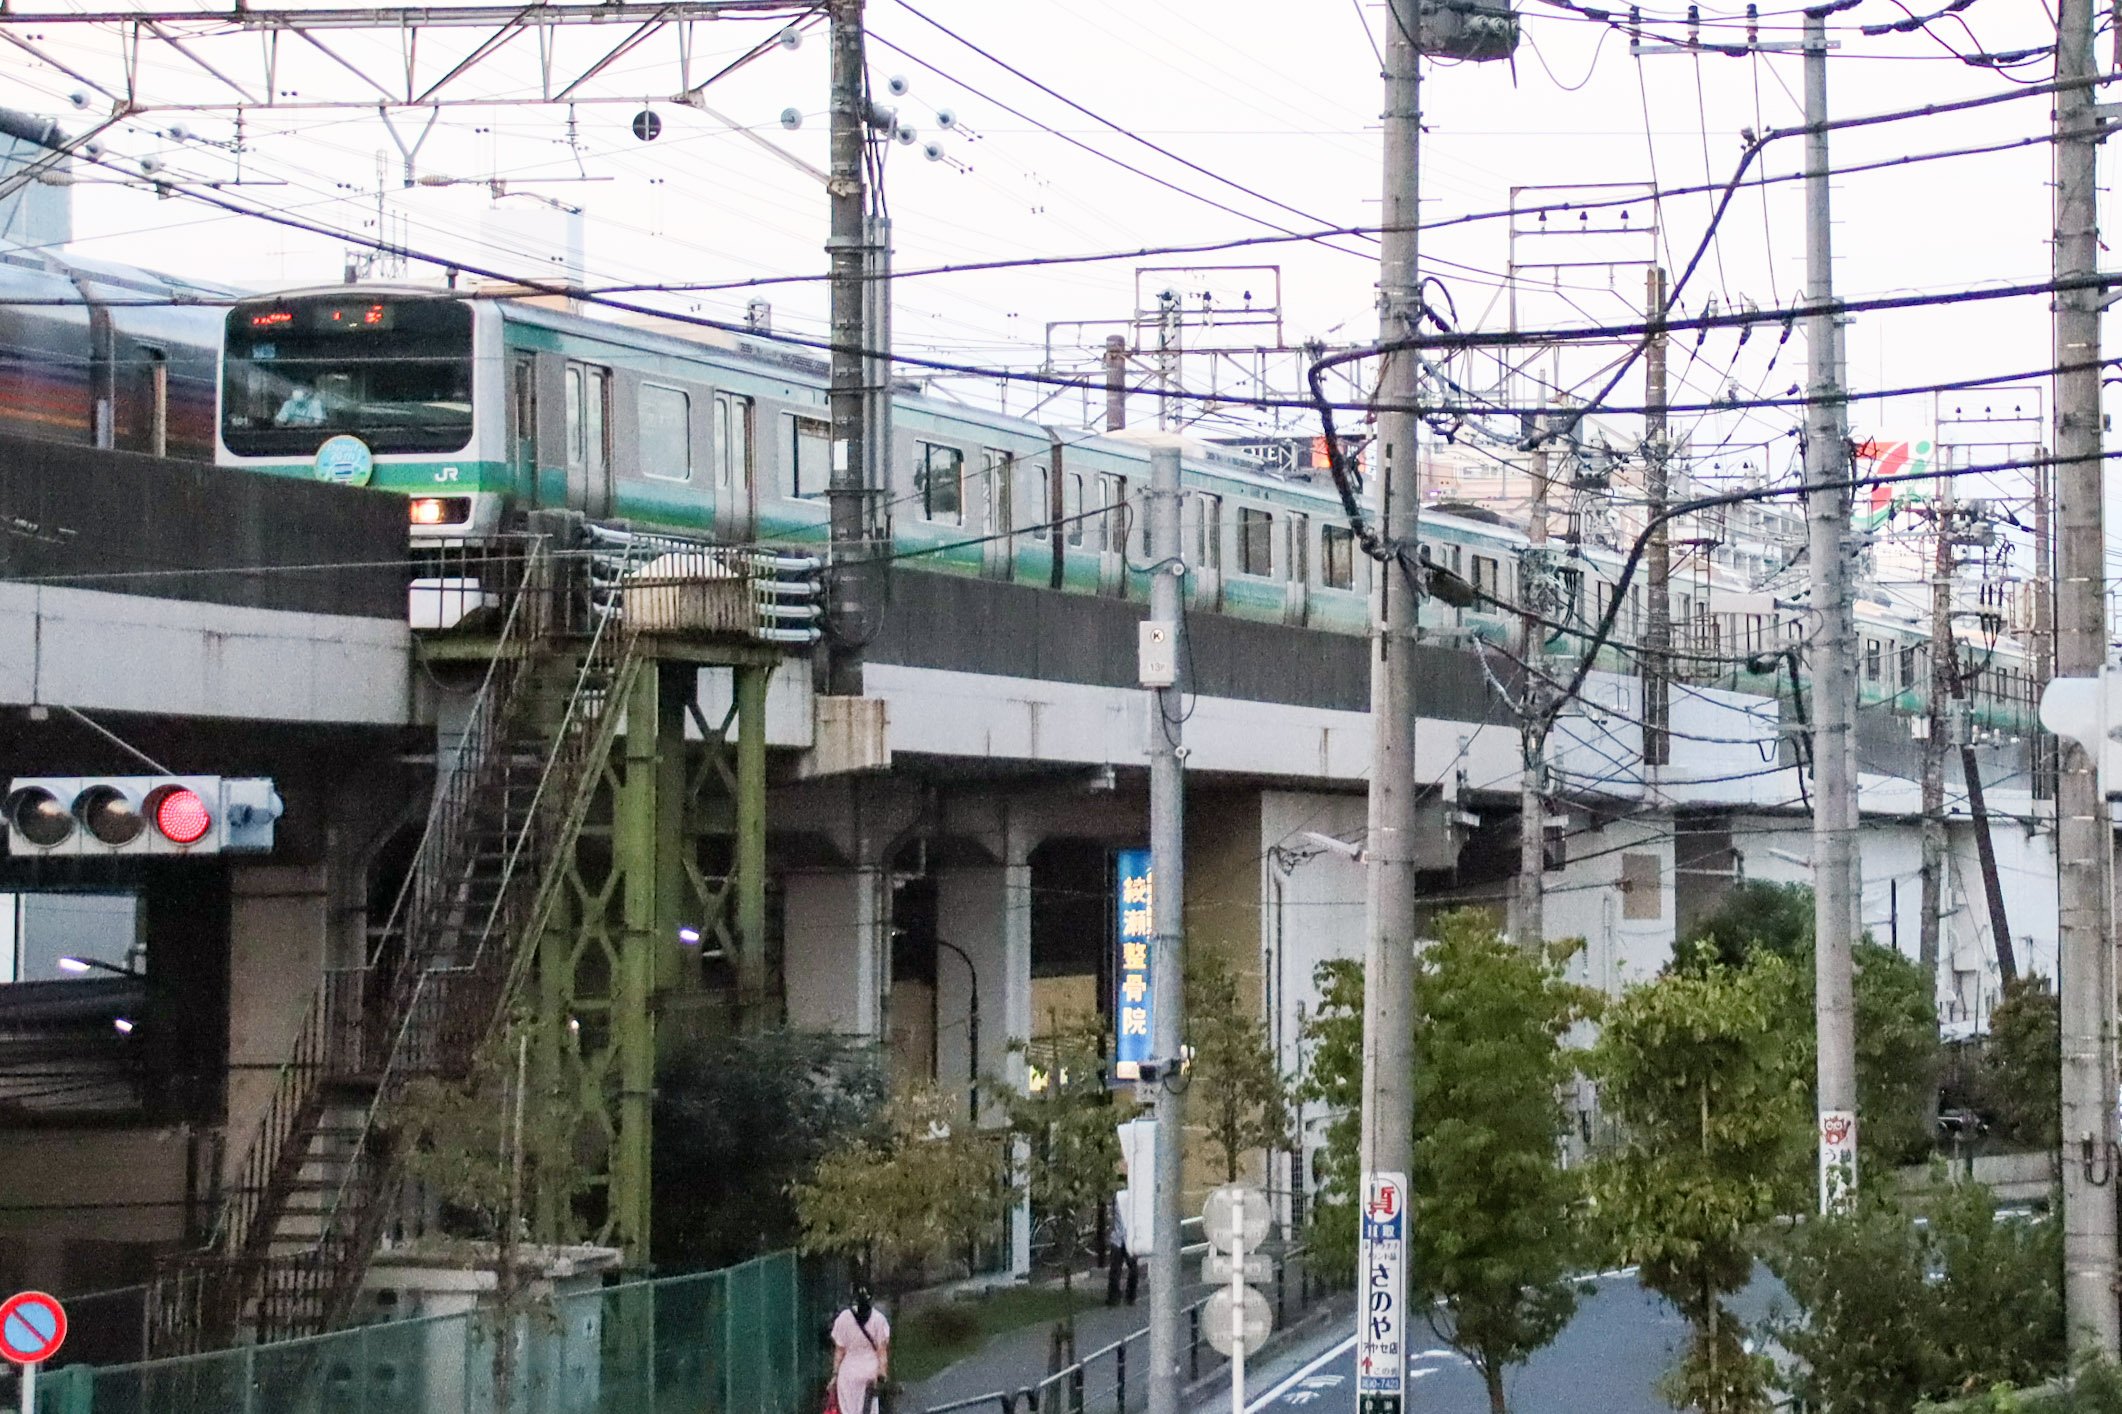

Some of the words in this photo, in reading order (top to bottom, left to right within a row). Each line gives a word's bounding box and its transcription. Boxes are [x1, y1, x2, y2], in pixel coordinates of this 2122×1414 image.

[434, 467, 459, 482] JR
[1370, 1263, 1392, 1340] さのや
